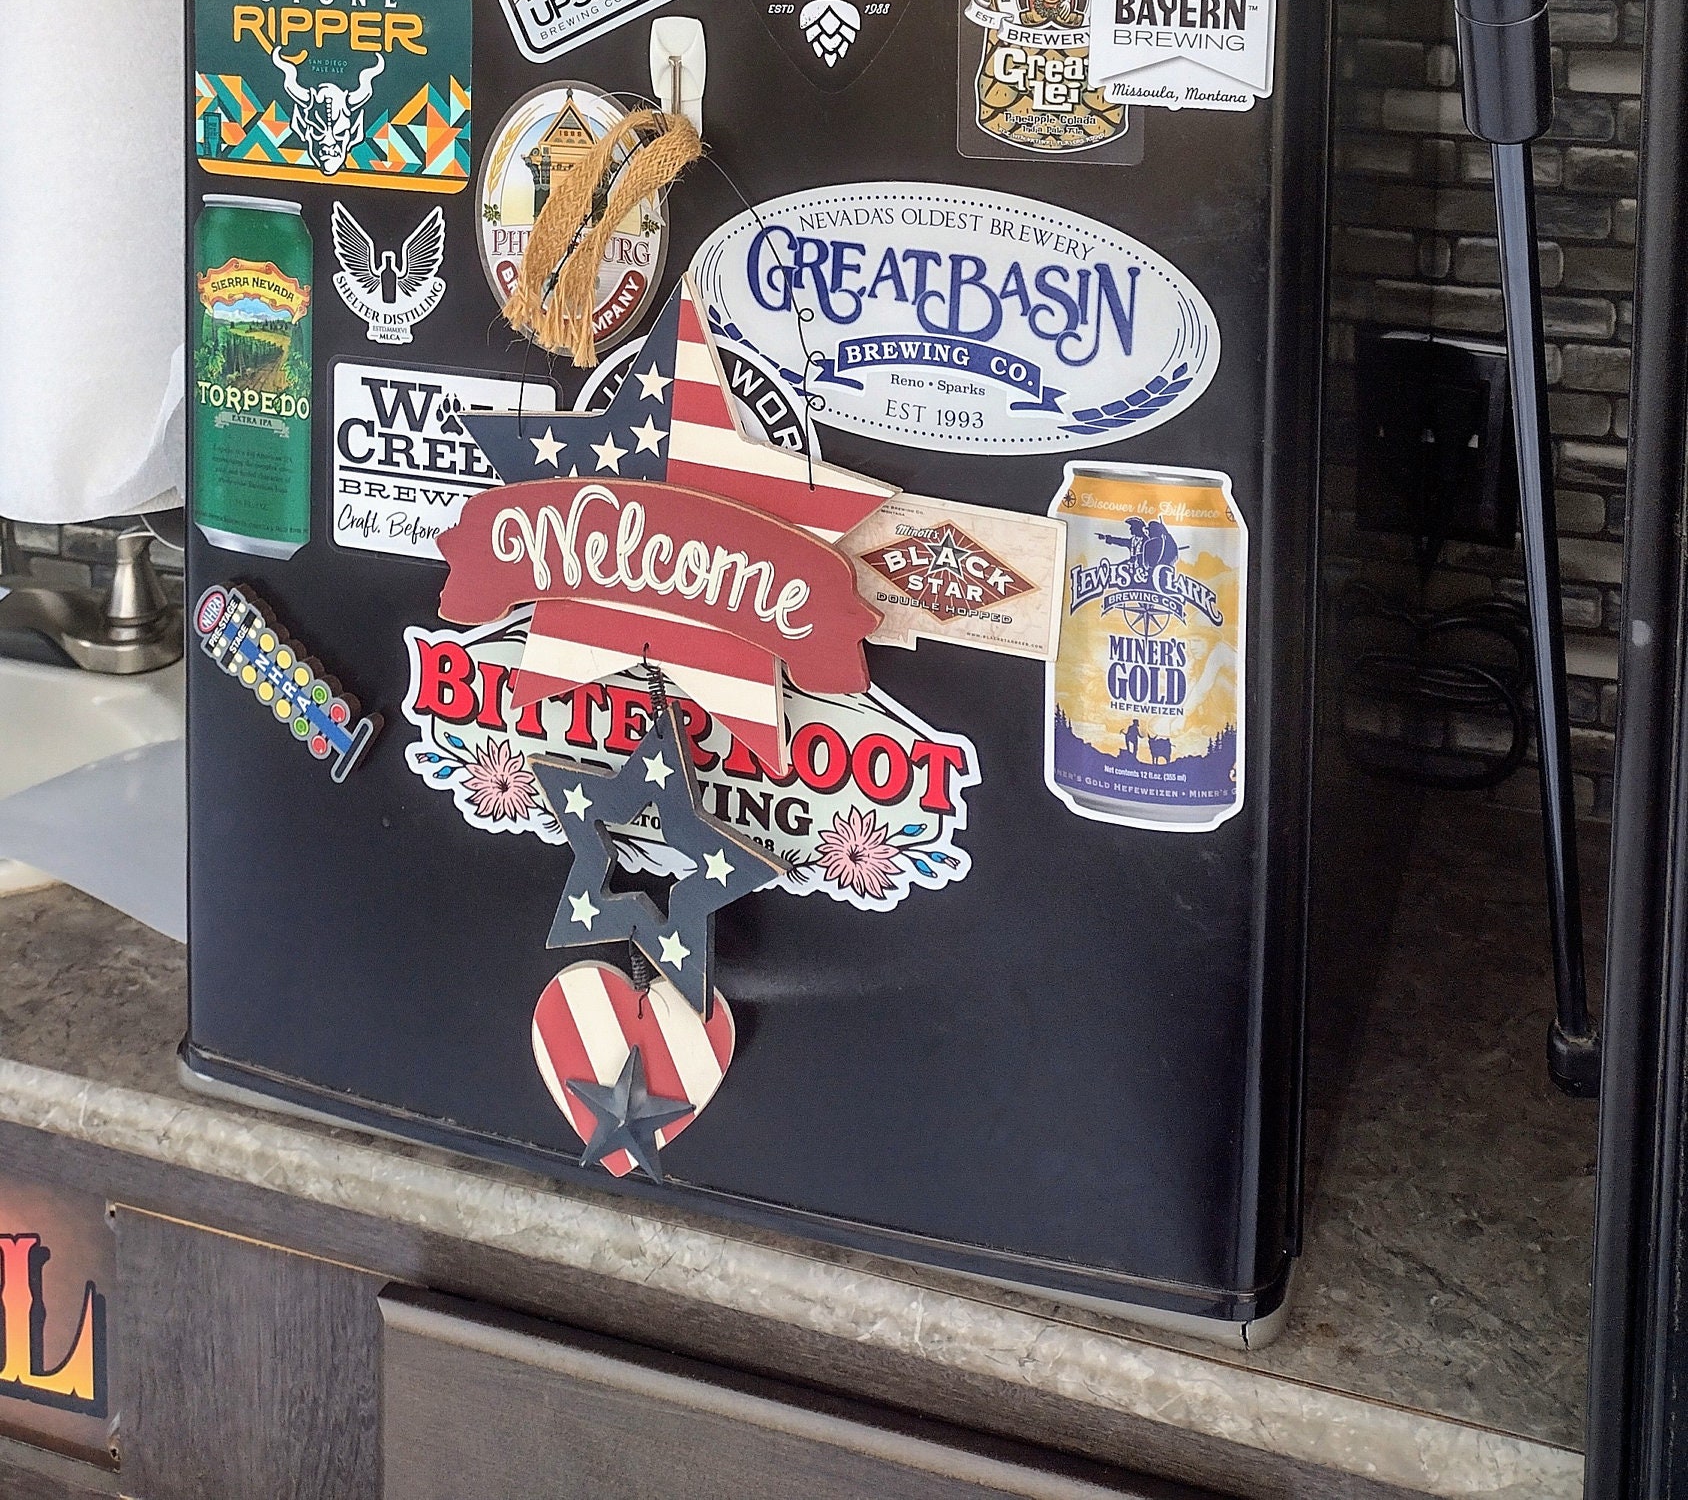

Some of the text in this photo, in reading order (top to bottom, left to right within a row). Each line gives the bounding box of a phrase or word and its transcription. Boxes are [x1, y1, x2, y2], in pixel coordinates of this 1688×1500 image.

[540, 6, 600, 40] BREWING
[767, 3, 891, 15] ESTD 1988
[975, 11, 996, 25] EST.
[232, 5, 428, 65] RIPPER
[1113, 29, 1245, 51] BREWING
[993, 47, 1092, 91] Grea
[1029, 80, 1081, 112] Lei
[1111, 83, 1248, 104] Missoula, Montana
[1004, 112, 1056, 124] Pineapple
[799, 207, 1096, 262] NEVADA'S OLDEST BREWERY
[210, 276, 295, 302] SIERRA NEVADA
[336, 275, 443, 325] SHELTER DISTILLING
[844, 343, 1034, 386] BREWING CO.
[196, 380, 310, 420] TORPEDO
[890, 374, 987, 397] Reno Sparks
[231, 414, 273, 427] EXTRA IPA
[885, 399, 985, 429] EST 1993
[337, 417, 494, 480] CREE
[1081, 492, 1220, 521] Discover the Difference
[337, 504, 381, 538] Craft.
[386, 511, 440, 544] Before
[491, 484, 815, 639] Welcome
[882, 545, 1015, 596] BLACK
[907, 575, 984, 603] STAR
[1070, 558, 1223, 626] LEWIS & CLARK
[1108, 591, 1180, 612] BREWING CO.
[202, 596, 222, 628] NHRA
[208, 599, 238, 648] PRE-STAGE
[876, 592, 1013, 624] DOUBLE HOPPED
[229, 624, 249, 654] STAGE
[1109, 635, 1186, 667] MINER'S
[255, 653, 311, 713] NHRA
[1107, 662, 1187, 705] GOLD
[1110, 701, 1184, 716] HEFEWEIZEN
[1085, 777, 1110, 789] GOLD
[1113, 783, 1178, 798] HEFEWEIZEN
[1189, 788, 1228, 798] MINER'S
[1140, 771, 1148, 779] 12
